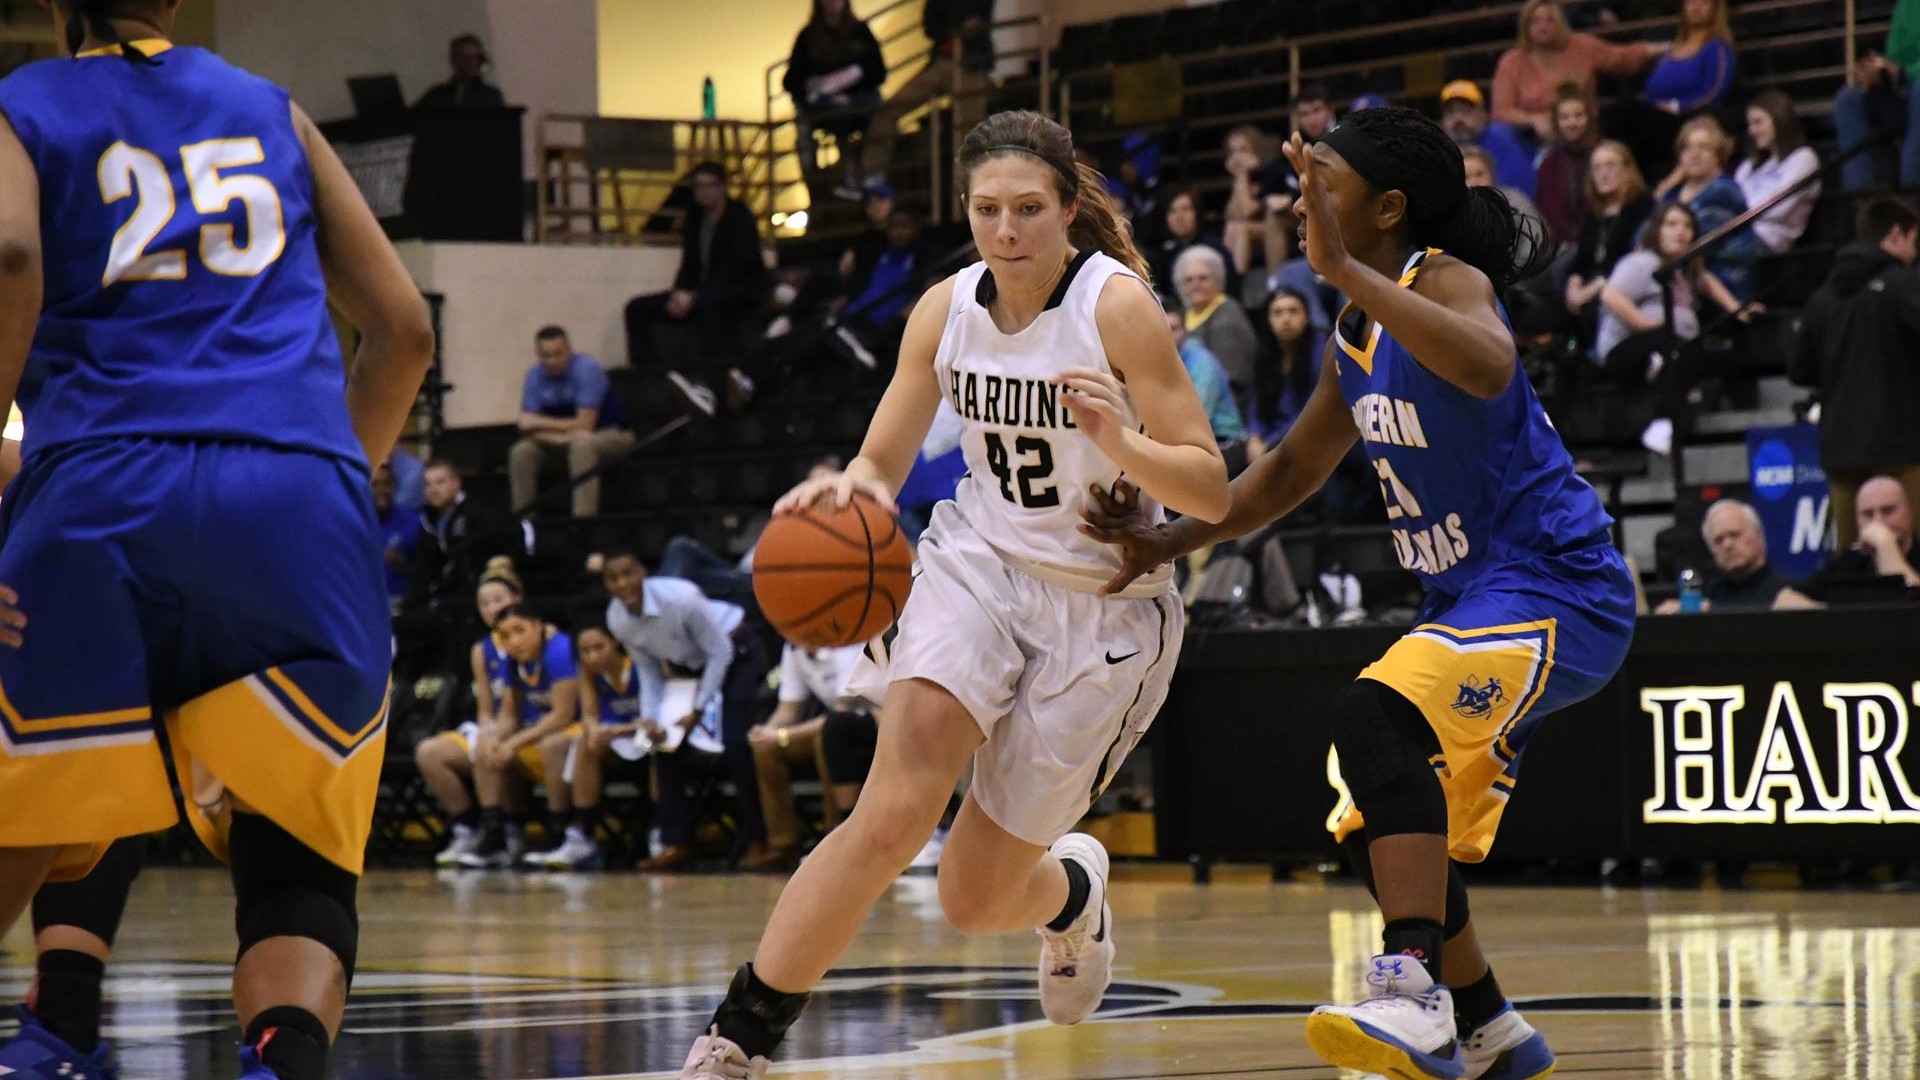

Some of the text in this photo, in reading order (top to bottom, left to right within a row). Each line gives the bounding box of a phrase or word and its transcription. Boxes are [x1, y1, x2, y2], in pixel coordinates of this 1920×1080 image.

[97, 137, 286, 288] 25
[984, 432, 1060, 509] 42
[1640, 681, 1920, 824] HAR
